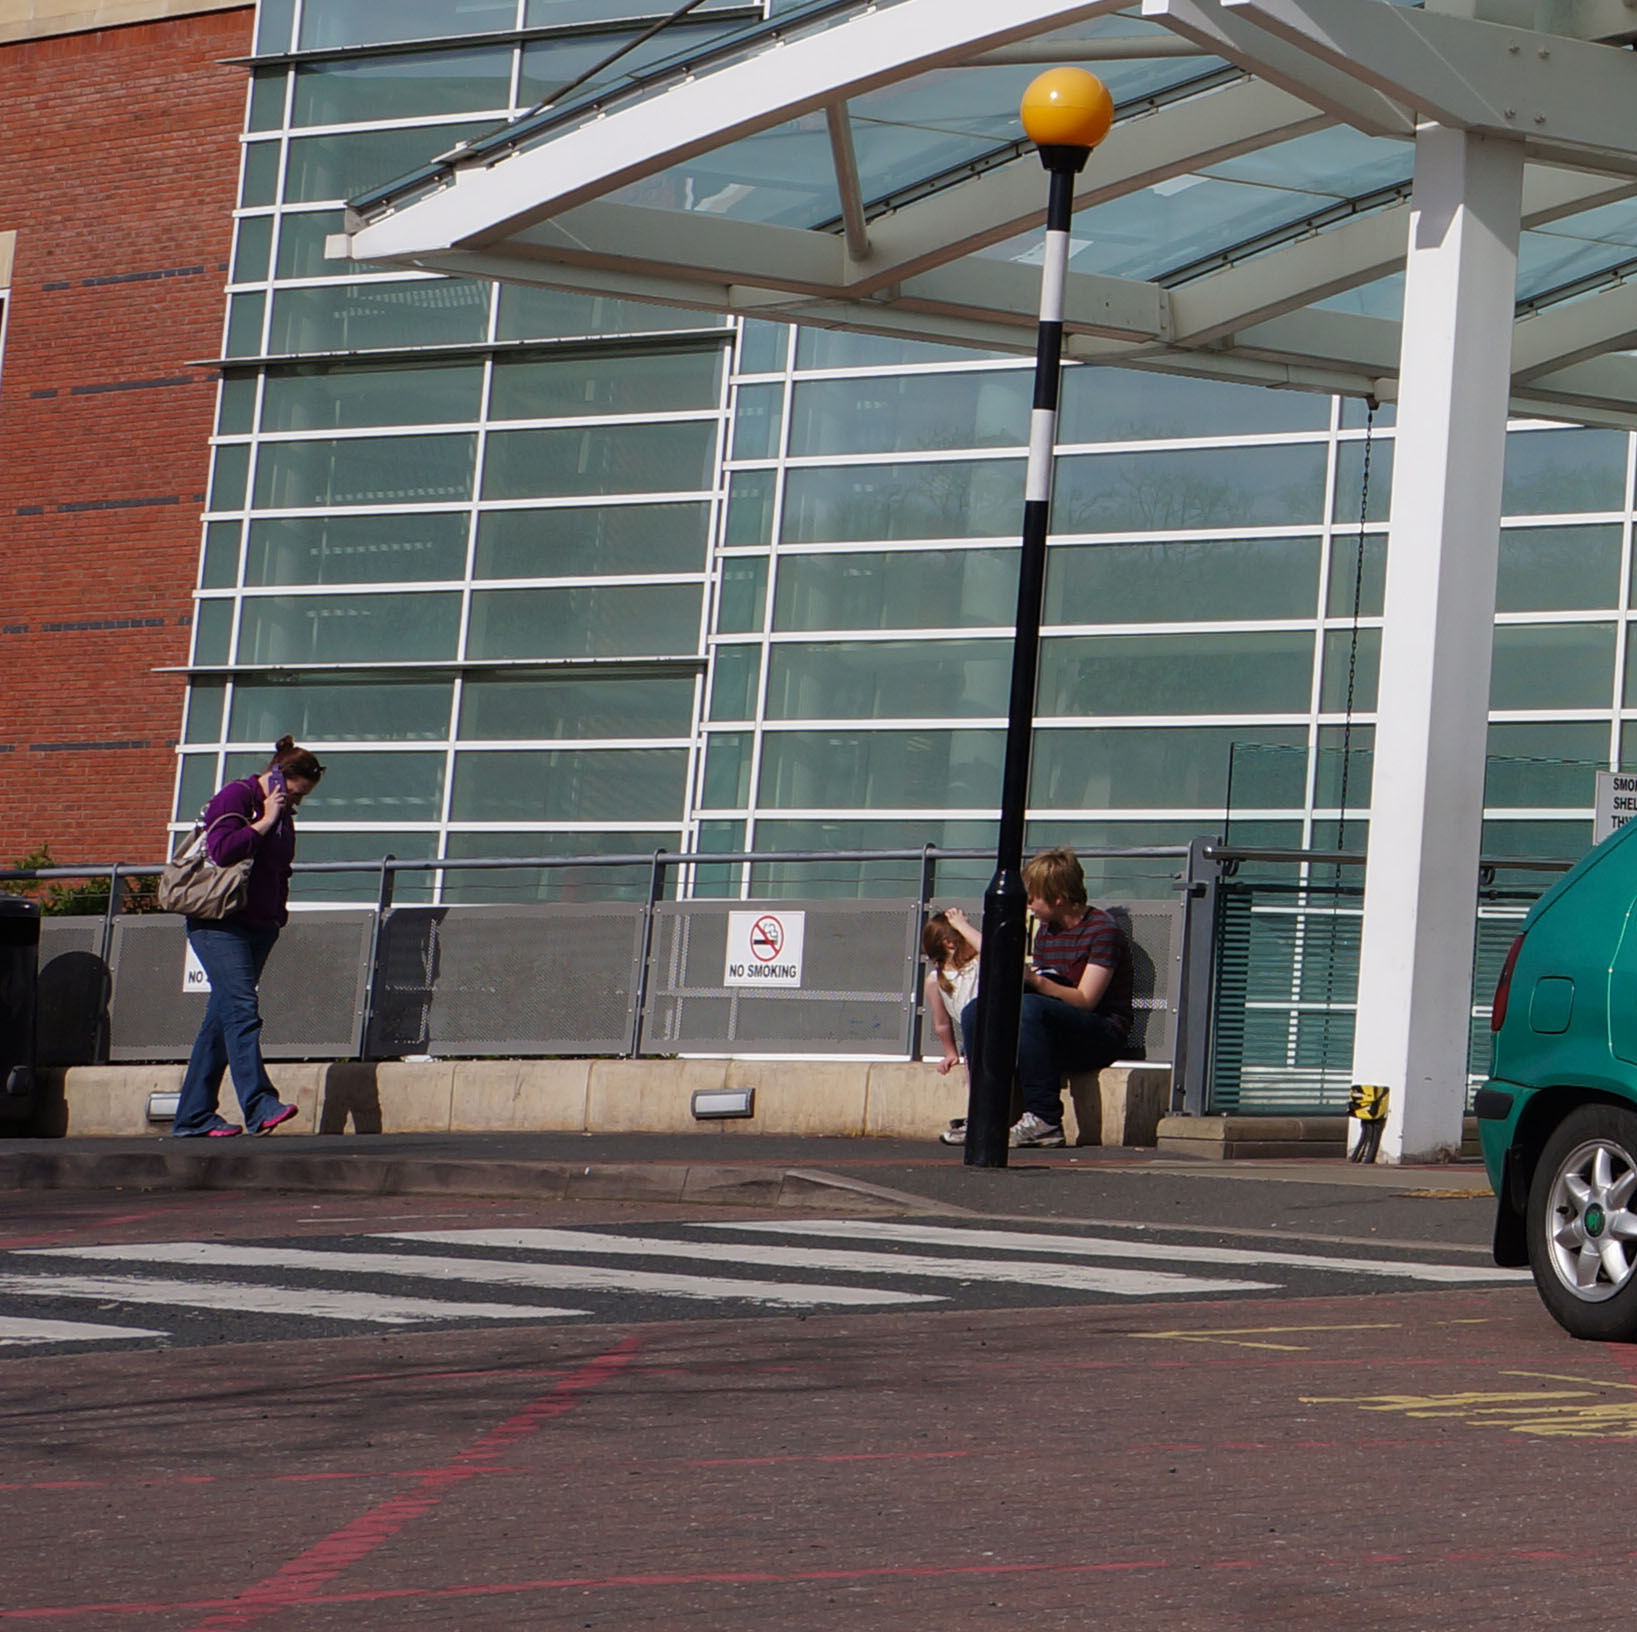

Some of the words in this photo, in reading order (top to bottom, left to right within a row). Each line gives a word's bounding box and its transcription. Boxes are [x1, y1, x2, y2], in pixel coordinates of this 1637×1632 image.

[188, 970, 204, 984] NO
[729, 963, 745, 977] NO
[747, 963, 797, 978] SMOKING
